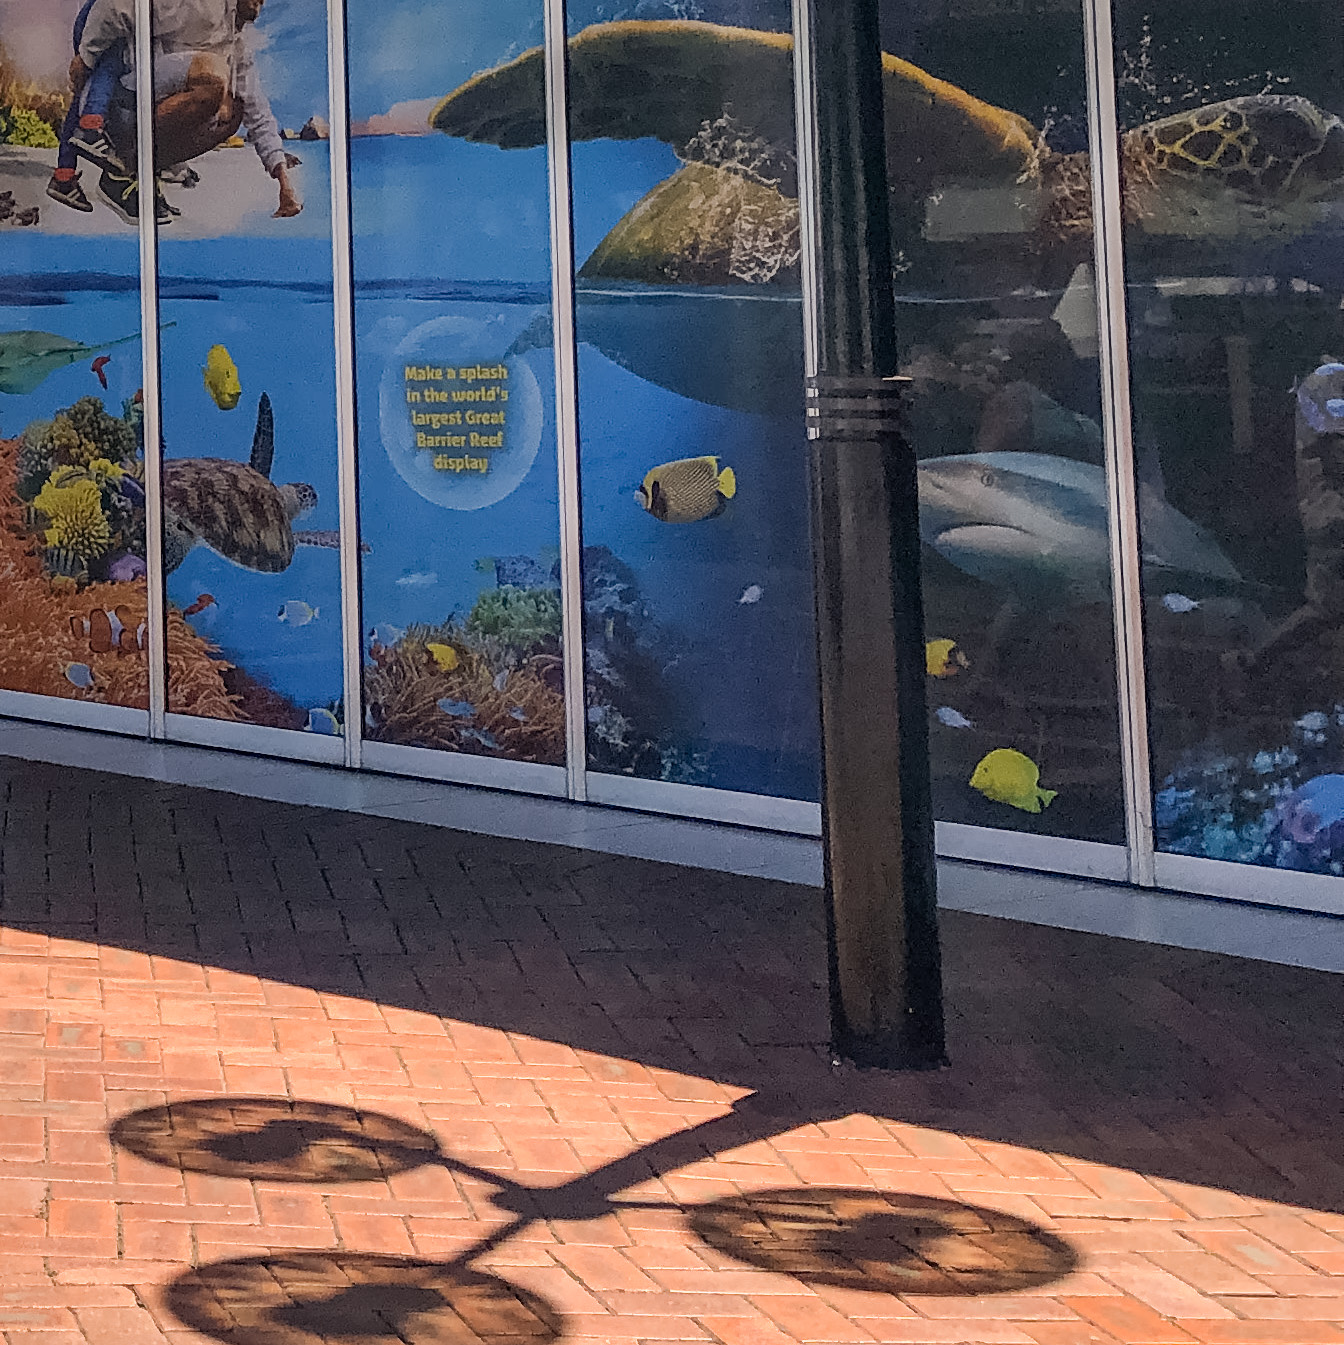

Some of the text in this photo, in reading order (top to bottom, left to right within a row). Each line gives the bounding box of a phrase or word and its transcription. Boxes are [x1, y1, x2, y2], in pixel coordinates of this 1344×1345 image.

[405, 364, 508, 383] Make a splash
[406, 387, 509, 403] in the world's
[411, 410, 506, 429] largest Great
[416, 431, 504, 447] Barrier Reef
[434, 454, 488, 473] display
